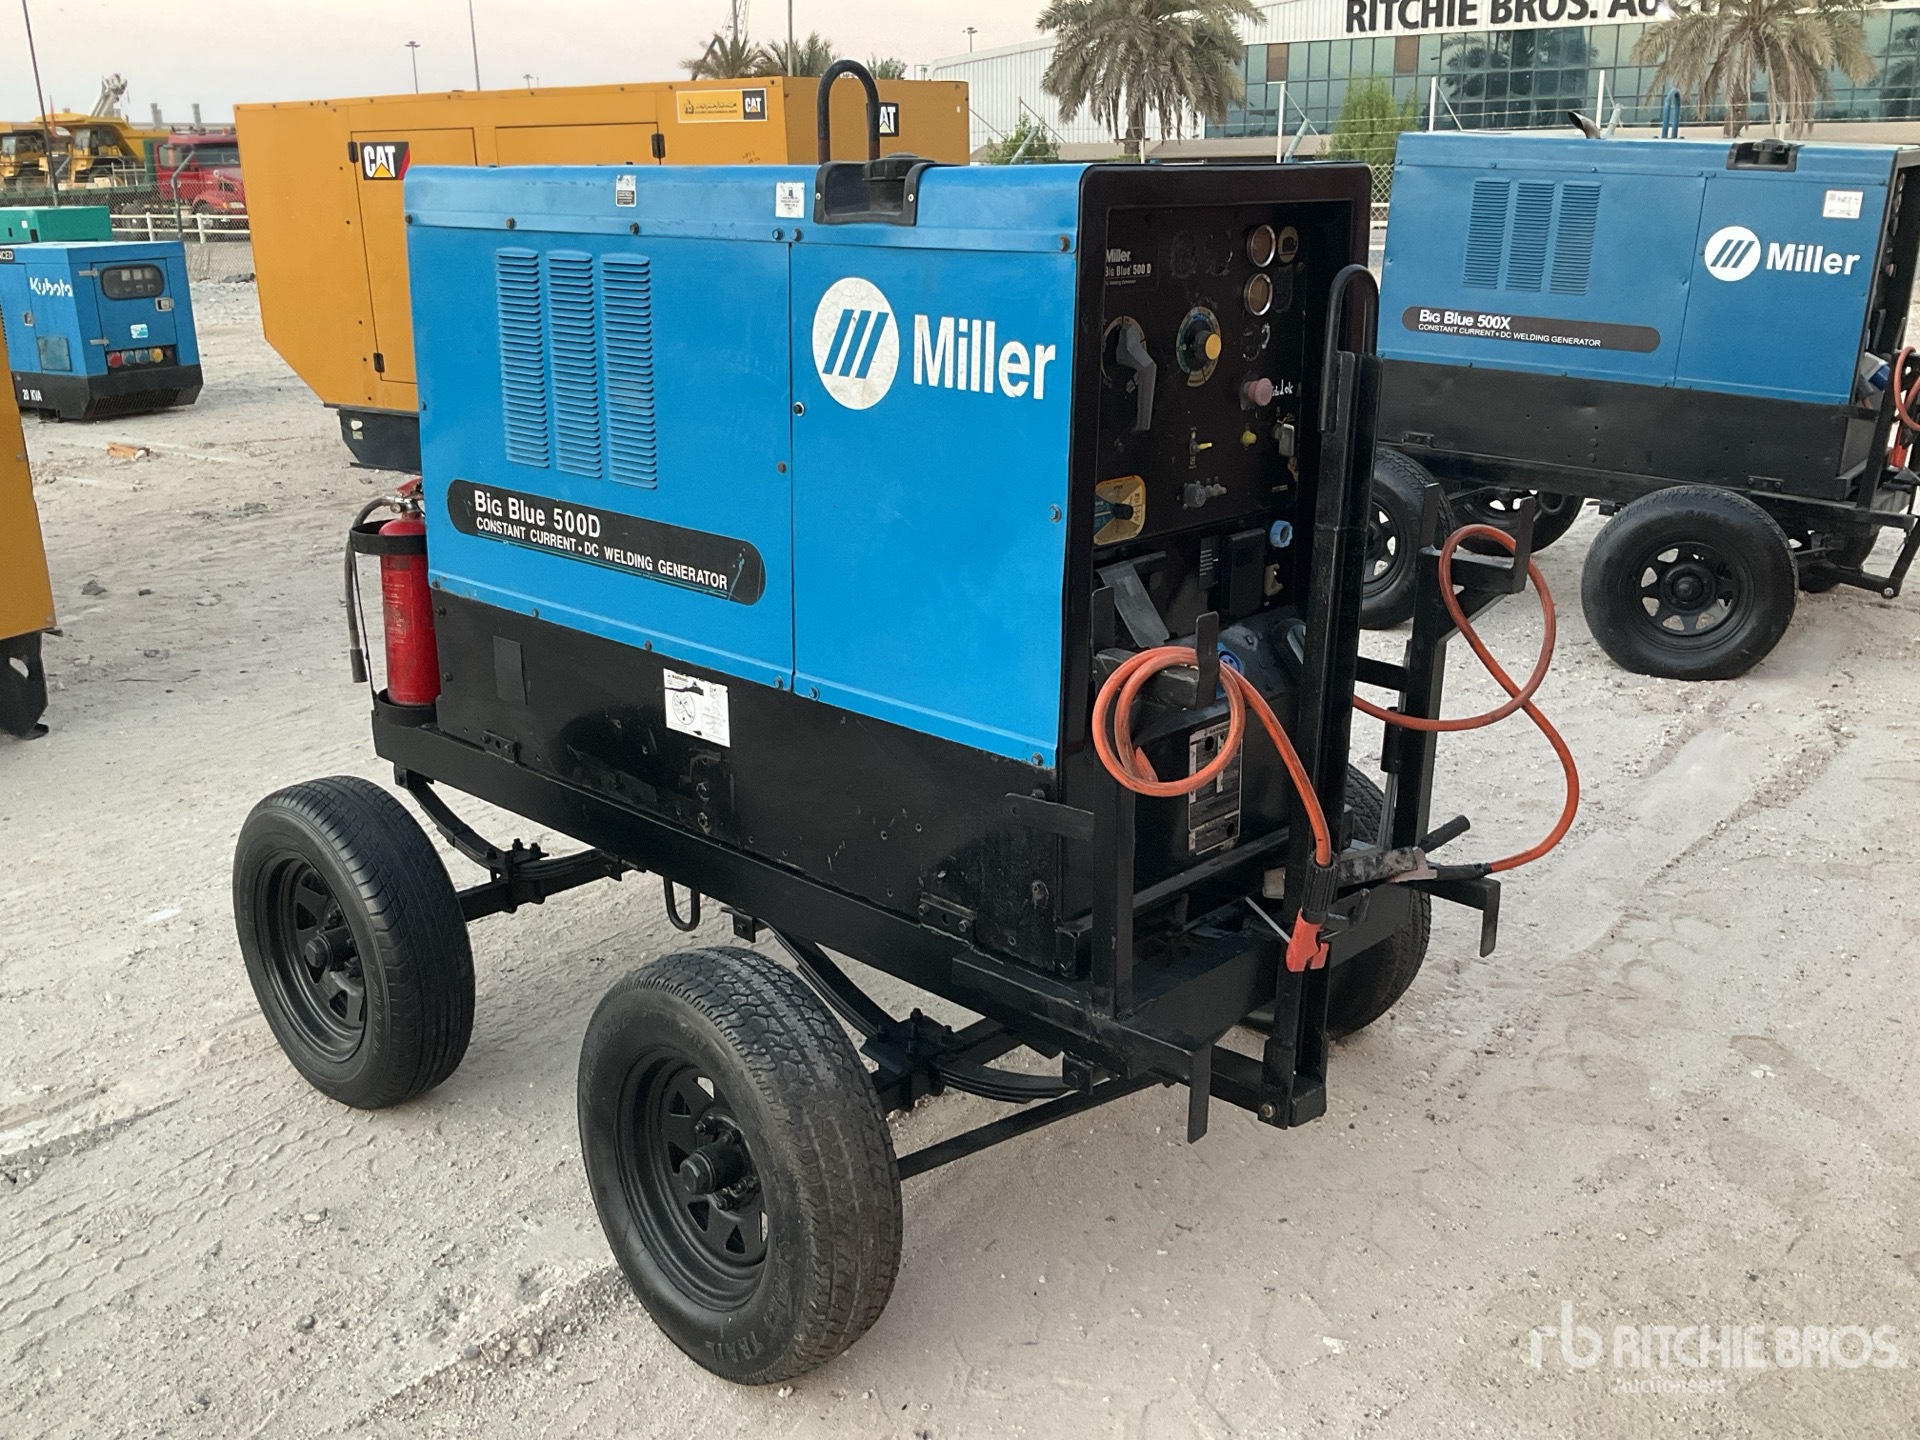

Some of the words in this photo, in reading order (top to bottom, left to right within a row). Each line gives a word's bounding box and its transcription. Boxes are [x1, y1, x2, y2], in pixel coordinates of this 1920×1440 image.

[1346, 0, 1478, 32] RITCHIE
[1489, 0, 1598, 24] BROS.
[745, 97, 762, 113] CAT
[880, 106, 896, 134] AT
[363, 145, 396, 178] CAT
[1106, 248, 1131, 263] Miller
[1765, 242, 1861, 275] Miller
[1132, 263, 1146, 275] 500
[29, 276, 74, 297] Kubota
[1443, 311, 1474, 327] Blue
[1477, 313, 1511, 330] 500X
[1418, 323, 1458, 333] CONSTANT
[1513, 332, 1550, 343] WELDING
[1551, 336, 1602, 348] GENERATOR
[913, 313, 1057, 401] Miller
[22, 388, 30, 400] 20
[30, 389, 43, 402] KVA
[507, 496, 546, 527] Blue
[552, 507, 601, 538] 500D
[476, 516, 526, 541] CONSTANT
[603, 545, 654, 572] WELDING
[657, 558, 729, 591] GENERATOR
